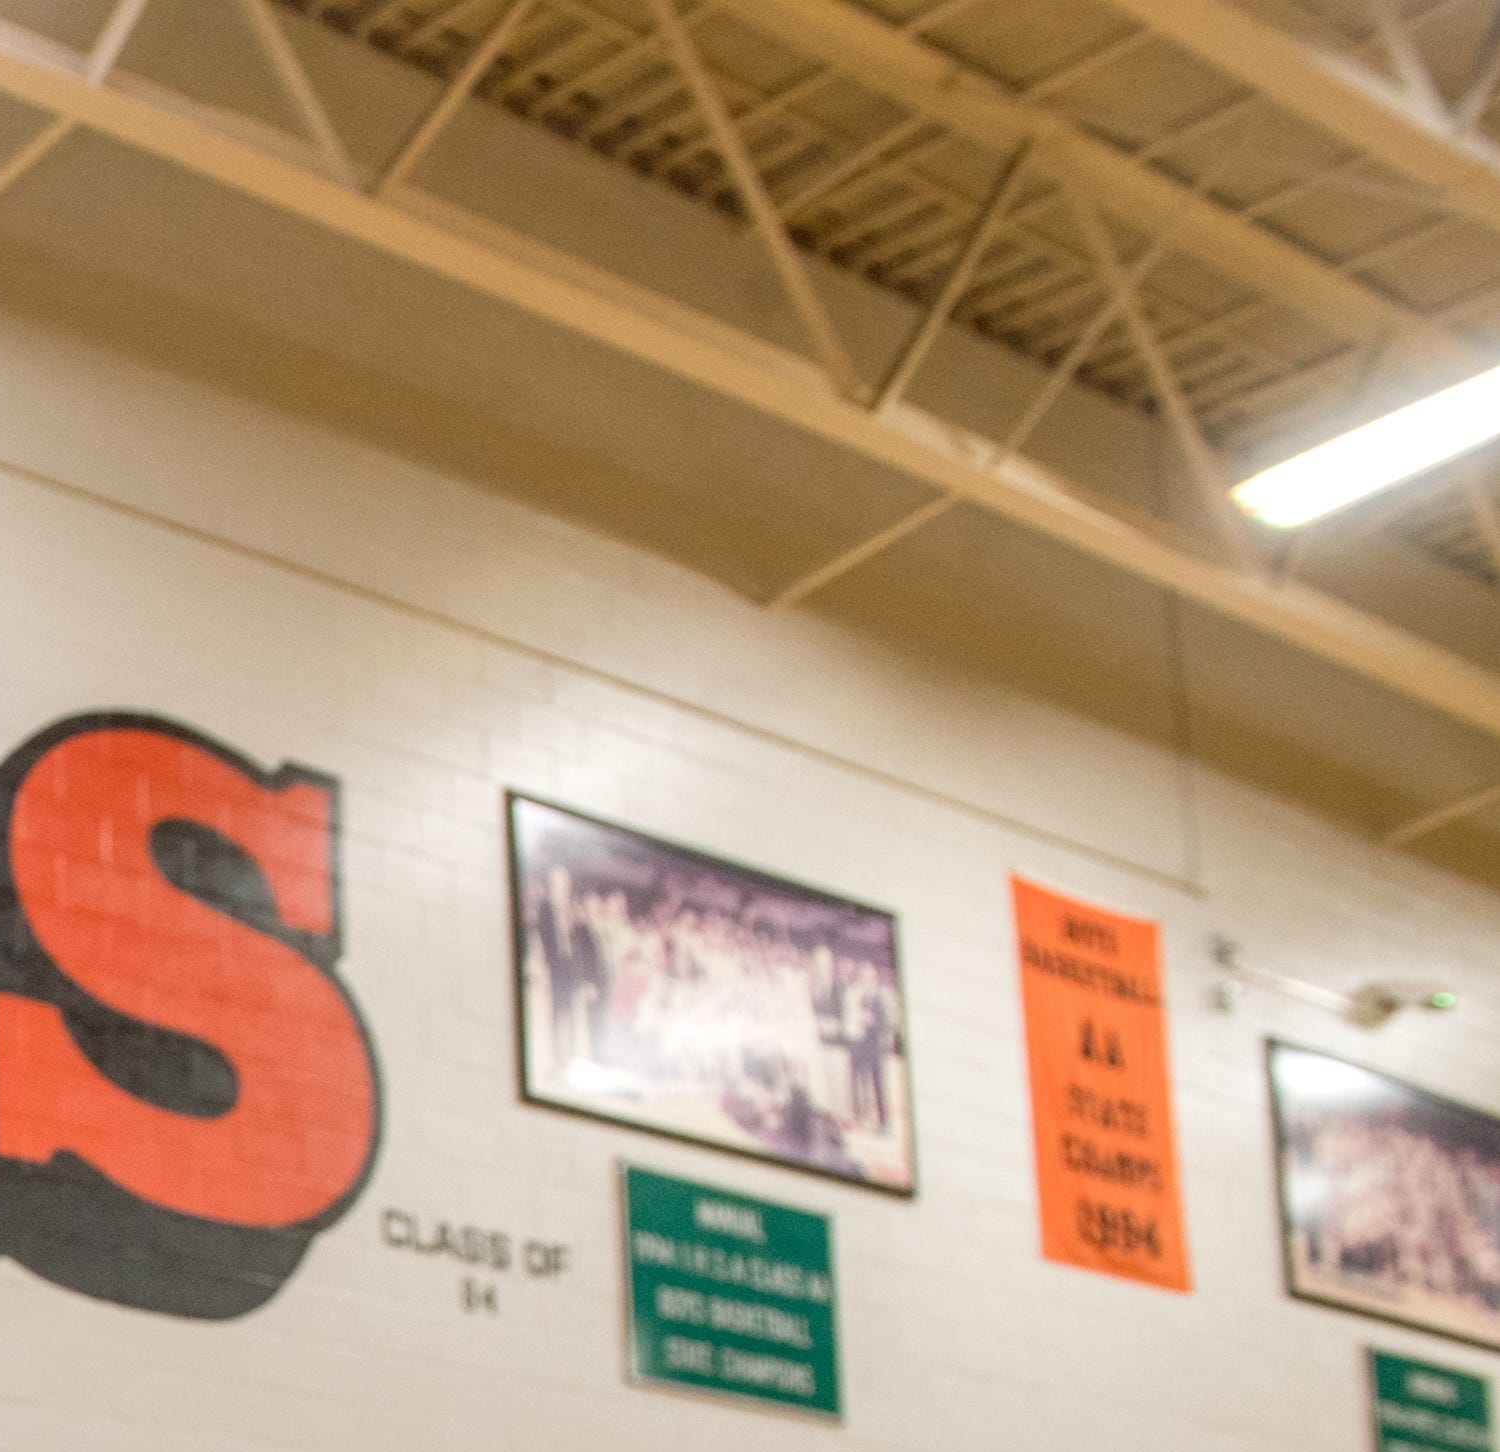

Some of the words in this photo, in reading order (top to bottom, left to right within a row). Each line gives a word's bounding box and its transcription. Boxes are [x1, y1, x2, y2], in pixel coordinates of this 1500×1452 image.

[1068, 1083, 1147, 1137] STATE
[1062, 1133, 1164, 1193] CHAMPS
[381, 1210, 510, 1269] CLASS
[524, 1241, 569, 1276] OF
